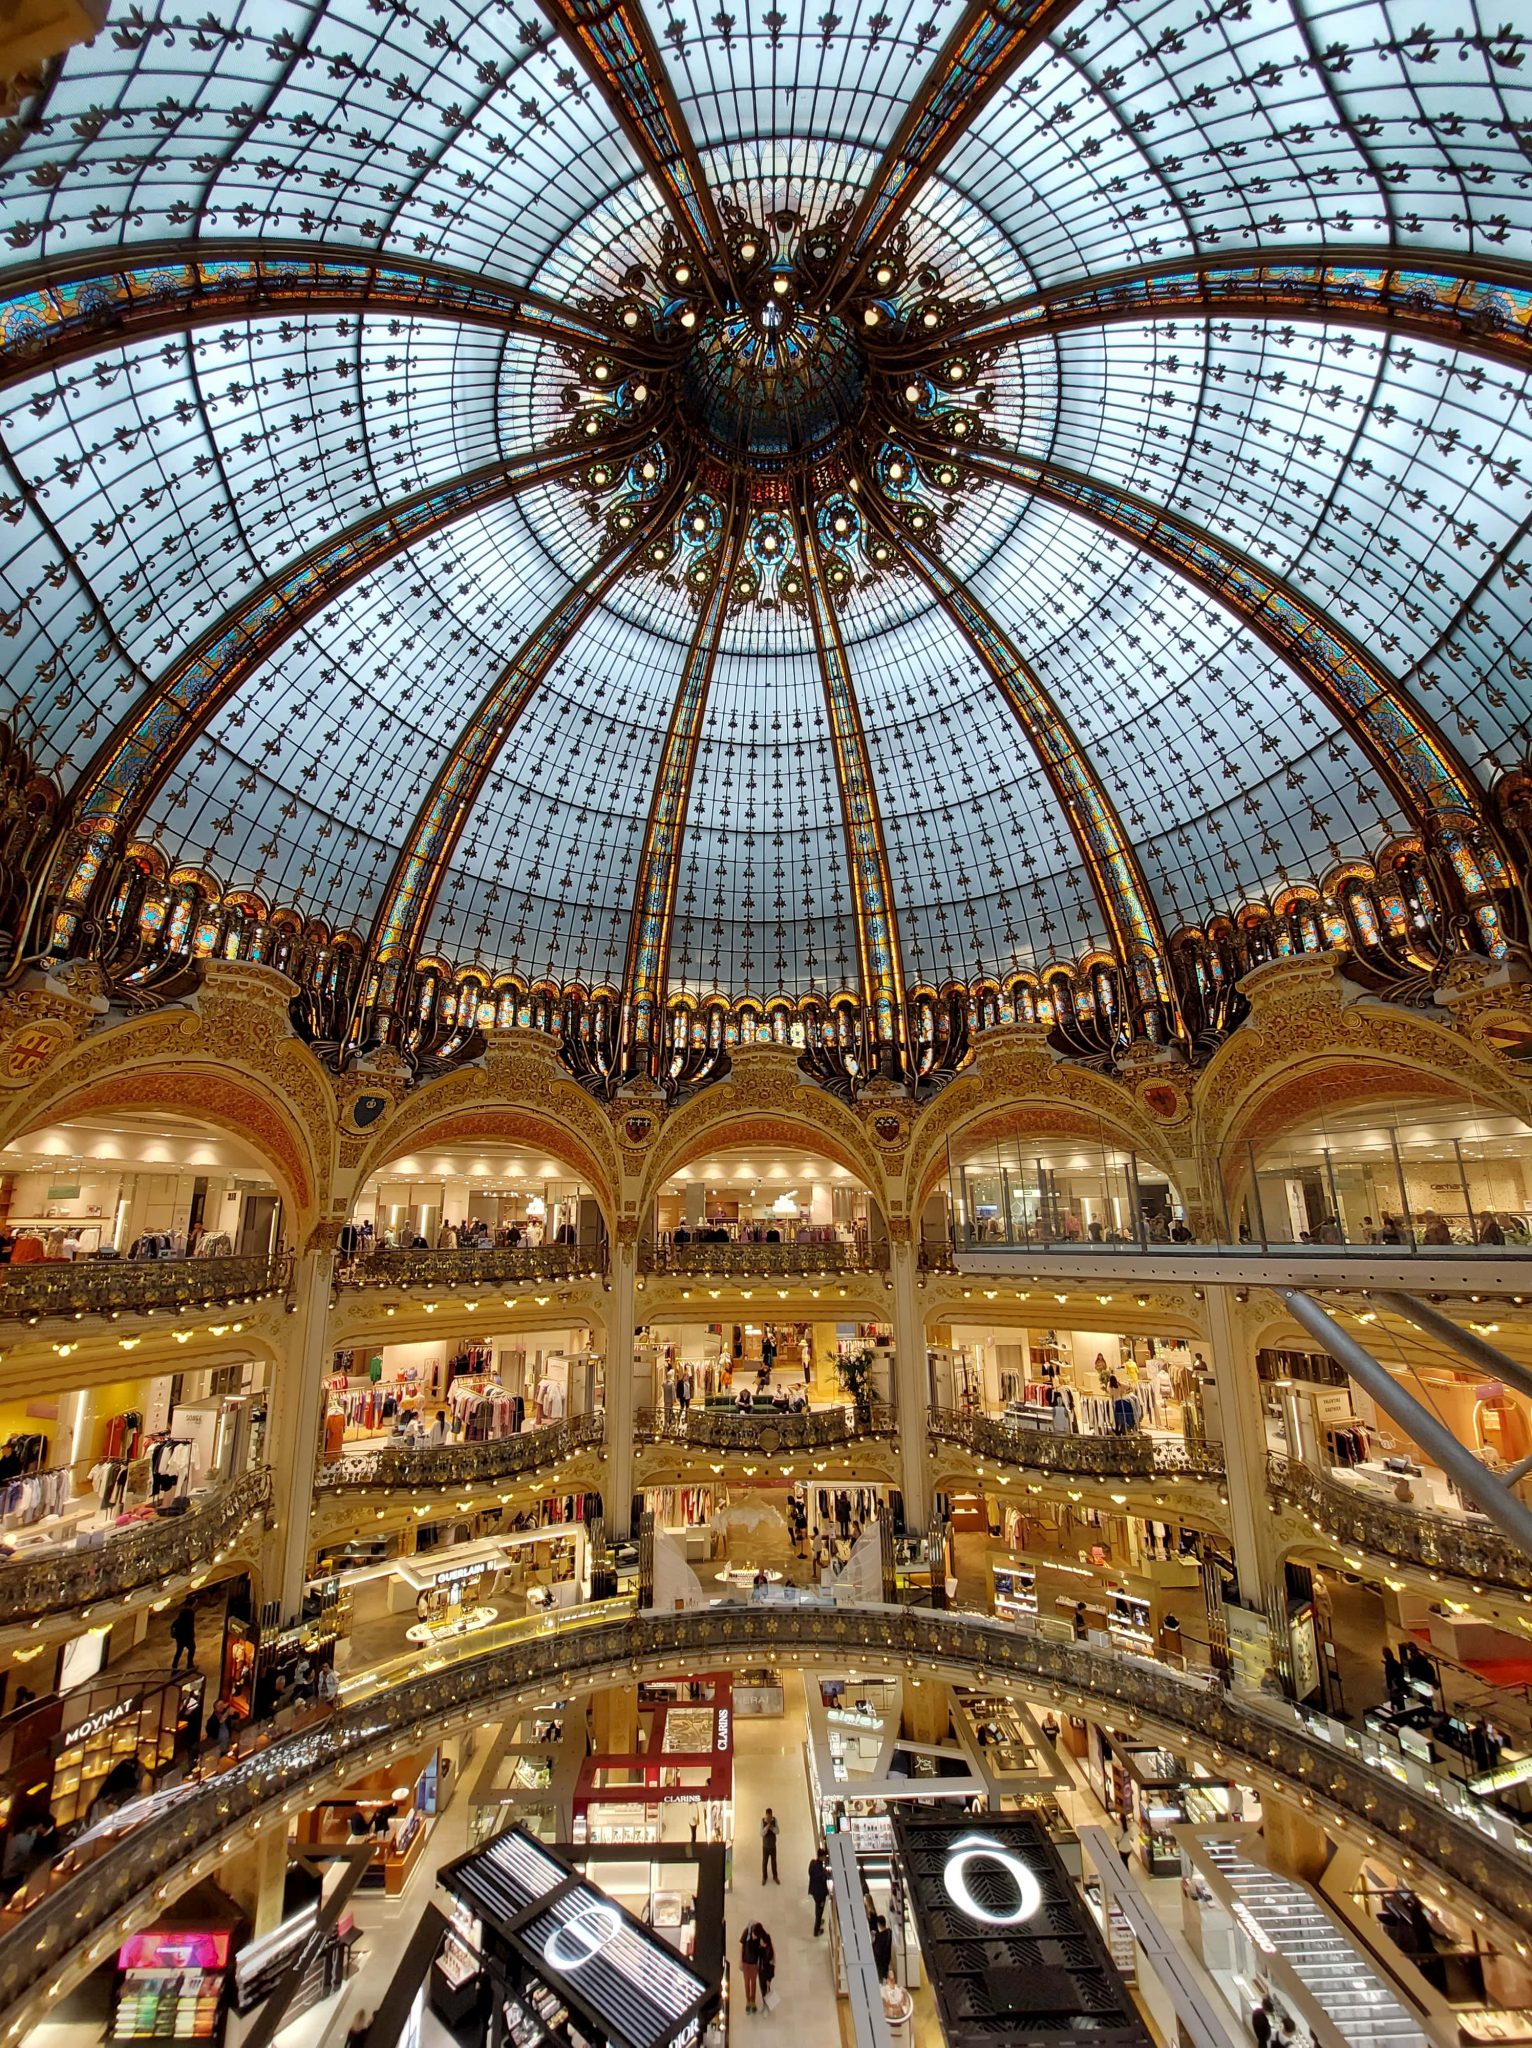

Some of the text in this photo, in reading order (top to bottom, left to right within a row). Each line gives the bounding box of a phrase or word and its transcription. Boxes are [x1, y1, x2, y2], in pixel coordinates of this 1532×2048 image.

[437, 1563, 485, 1584] GUERLAIN
[65, 1698, 133, 1746] MOYNAT
[717, 1708, 728, 1751] CLARINS
[663, 1795, 701, 1803] CLARINS
[668, 2016, 700, 2048] DIOR
